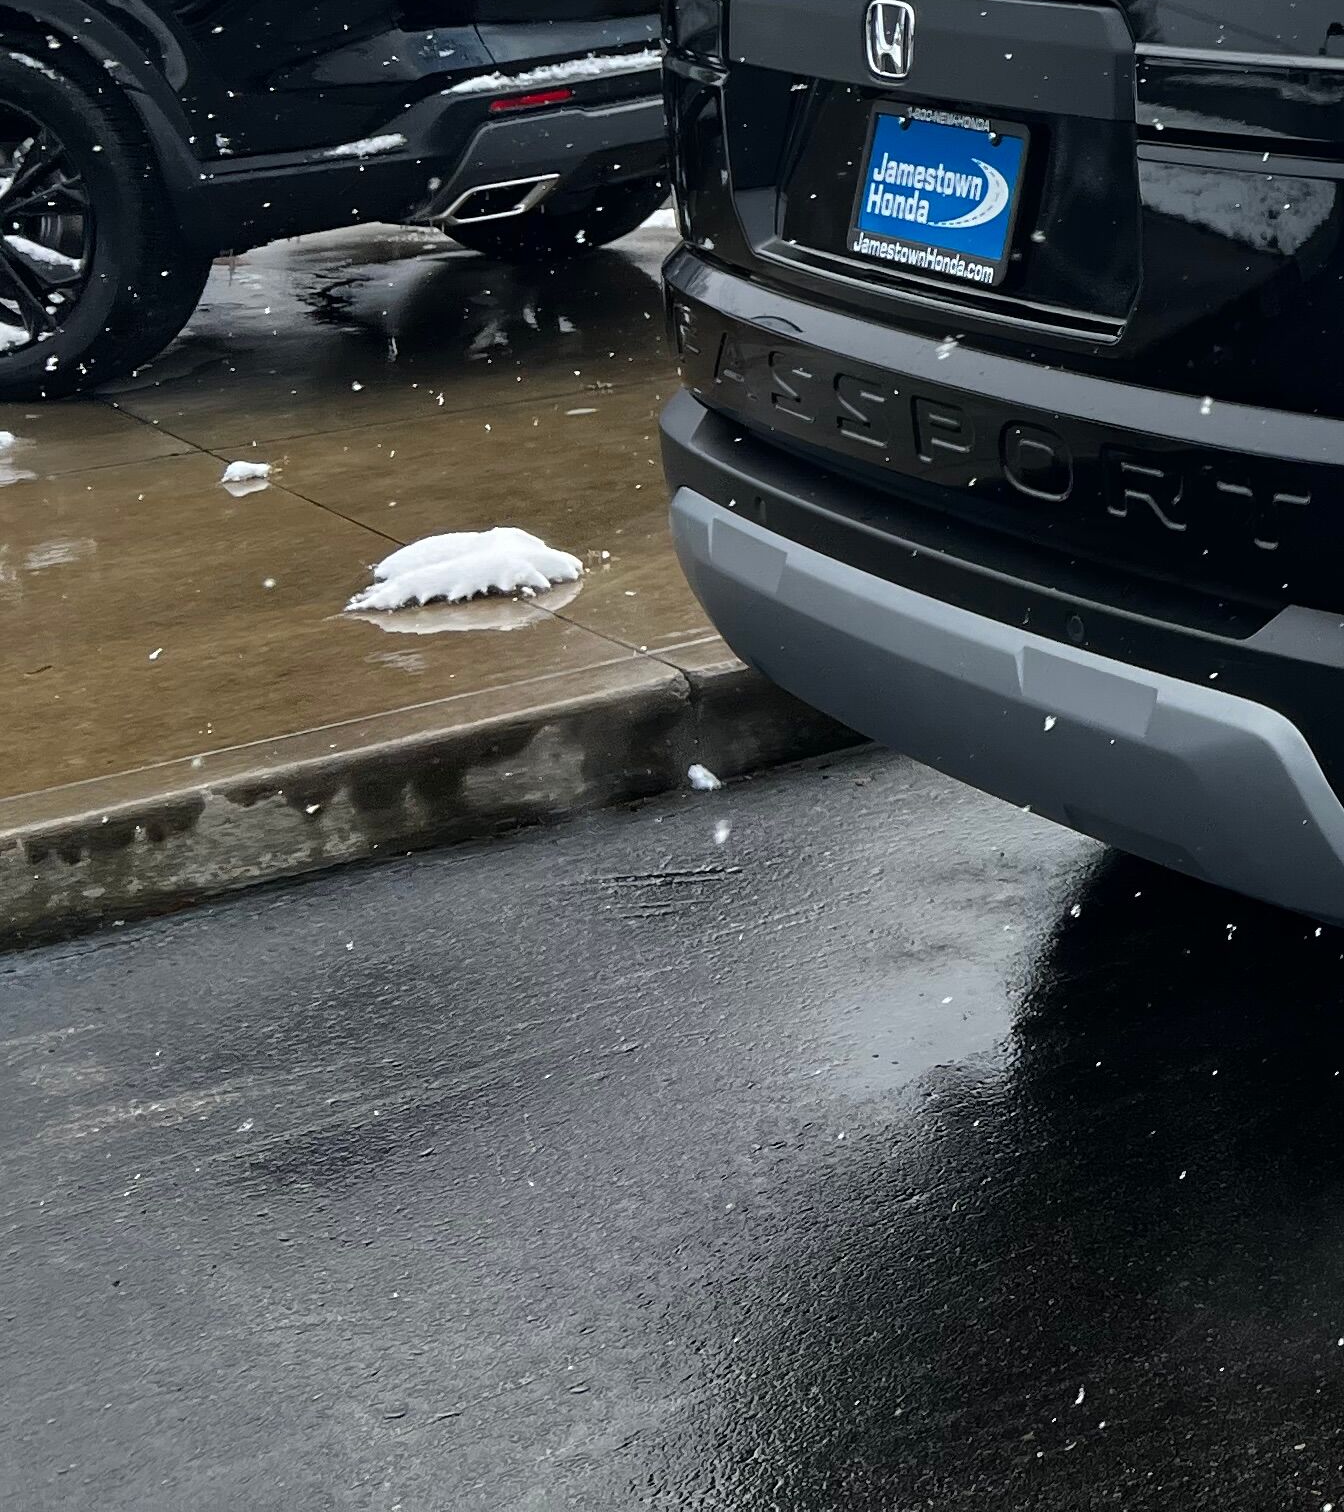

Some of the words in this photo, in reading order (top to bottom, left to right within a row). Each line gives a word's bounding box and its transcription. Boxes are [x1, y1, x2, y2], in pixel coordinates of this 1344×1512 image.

[873, 152, 983, 201] Jamestown
[866, 182, 930, 225] Honda
[853, 232, 994, 284] JamestownHonda.com
